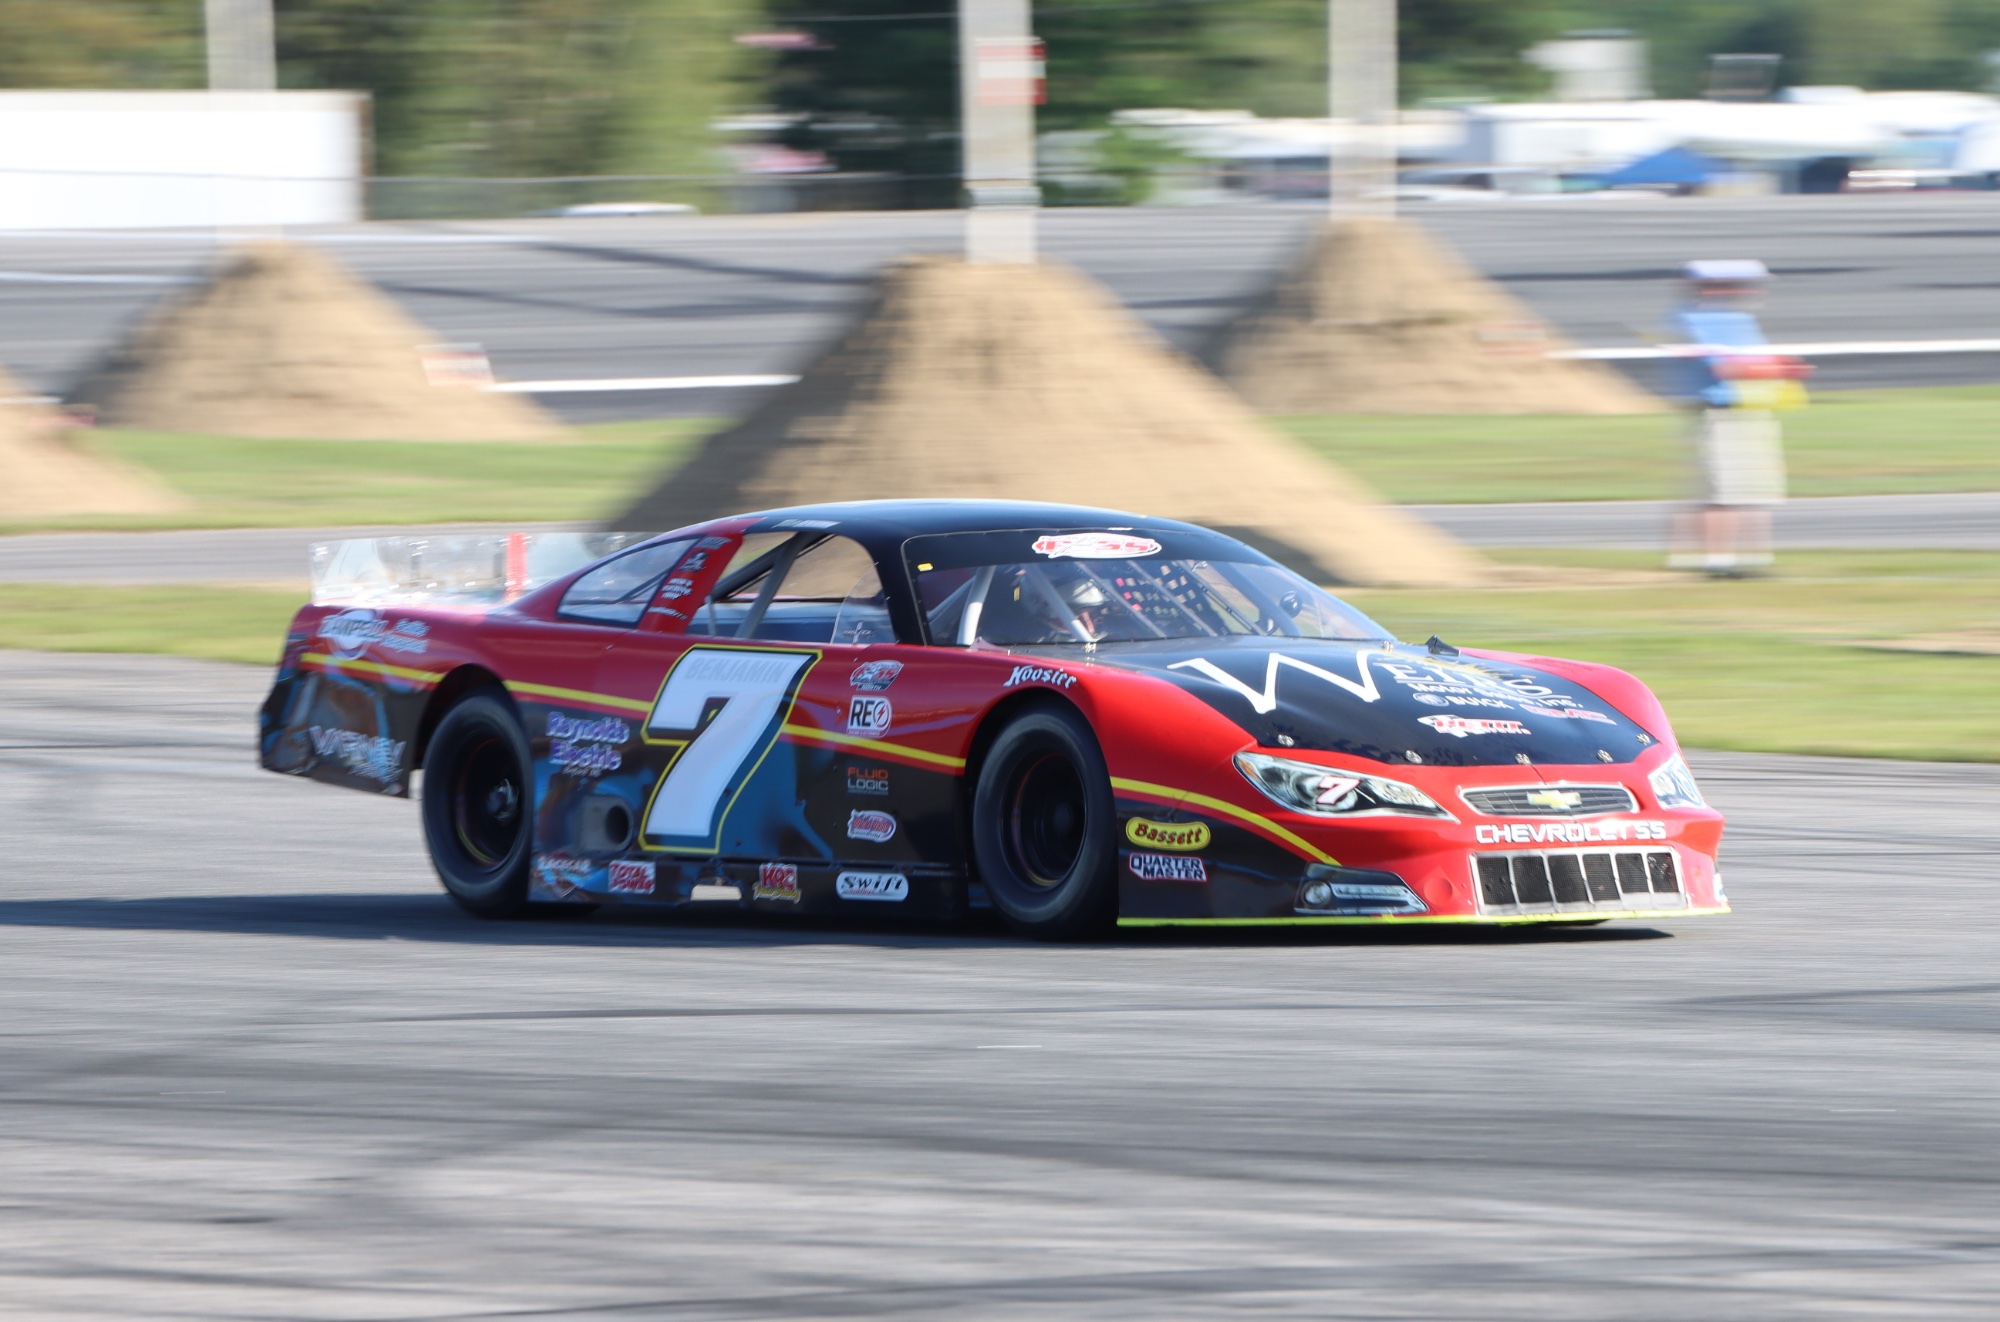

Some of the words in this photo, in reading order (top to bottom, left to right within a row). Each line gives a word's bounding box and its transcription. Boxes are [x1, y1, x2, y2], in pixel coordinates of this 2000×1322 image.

[684, 657, 790, 684] BENJAMIN
[1003, 664, 1077, 689] Hoosier
[1445, 695, 1515, 711] BUICK
[643, 647, 816, 842] 7
[847, 766, 889, 780] FLUID
[847, 778, 889, 792] LOGIC
[1316, 775, 1361, 805] 7
[1135, 823, 1202, 845] Bassett
[1475, 820, 1637, 845] CHEVROLET
[1635, 820, 1666, 840] SS
[1131, 855, 1201, 870] QUARTER
[1143, 867, 1203, 879] MASTER
[841, 875, 902, 893] Swift
